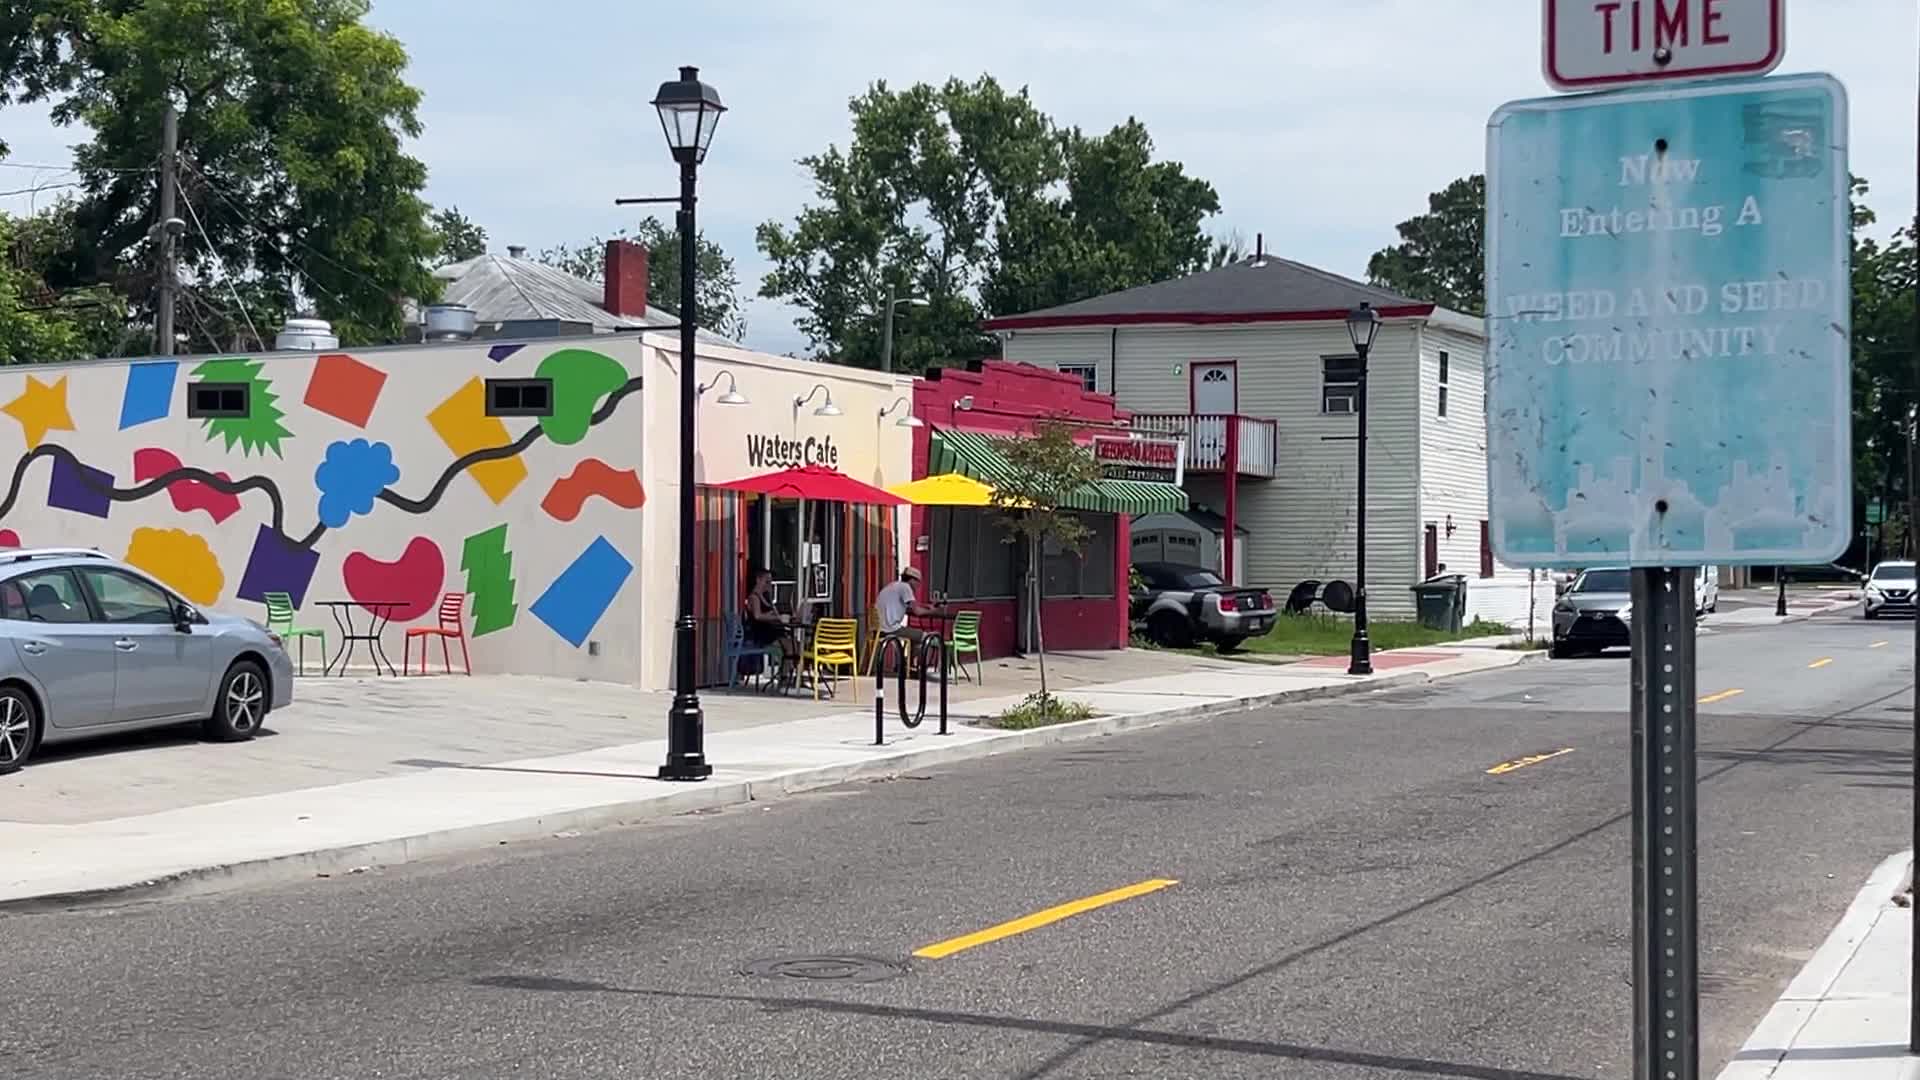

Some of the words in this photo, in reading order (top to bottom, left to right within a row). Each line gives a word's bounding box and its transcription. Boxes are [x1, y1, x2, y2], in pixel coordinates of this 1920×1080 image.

[1595, 0, 1730, 53] TIME
[1618, 155, 1702, 187] Now
[1560, 204, 1723, 238] Entering
[1736, 196, 1763, 226] A
[1506, 288, 1617, 323] WEED
[1624, 284, 1710, 316] AND
[1720, 280, 1825, 313] SEED
[1542, 323, 1785, 366] COMMUNITY
[747, 434, 802, 467] Waters
[804, 435, 838, 466] Cafe
